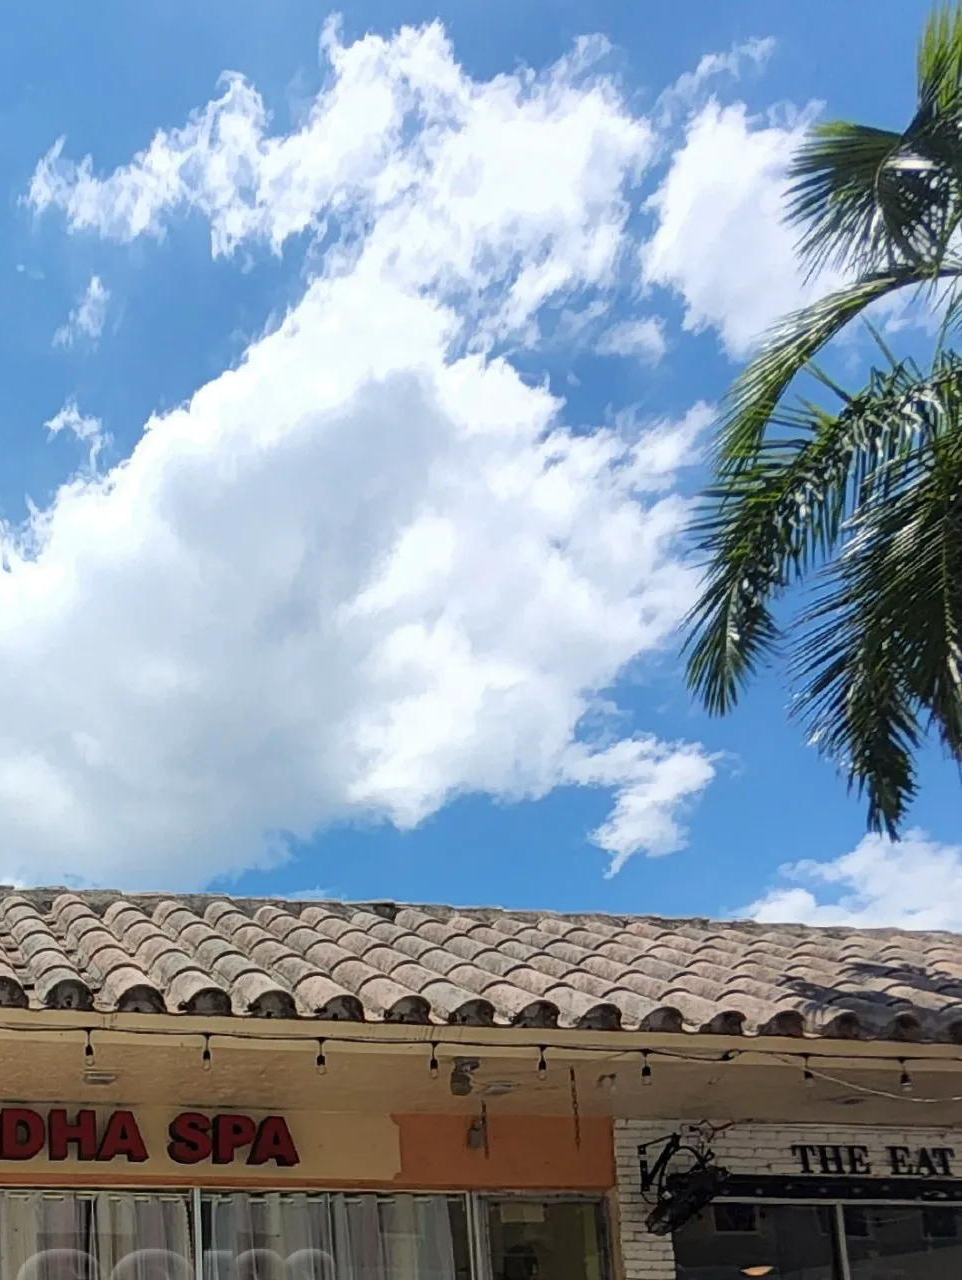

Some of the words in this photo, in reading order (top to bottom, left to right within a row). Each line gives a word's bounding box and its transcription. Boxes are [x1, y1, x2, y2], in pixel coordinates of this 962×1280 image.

[166, 1111, 301, 1168] SPA
[790, 1144, 871, 1175] THE
[884, 1145, 956, 1177] EAT
